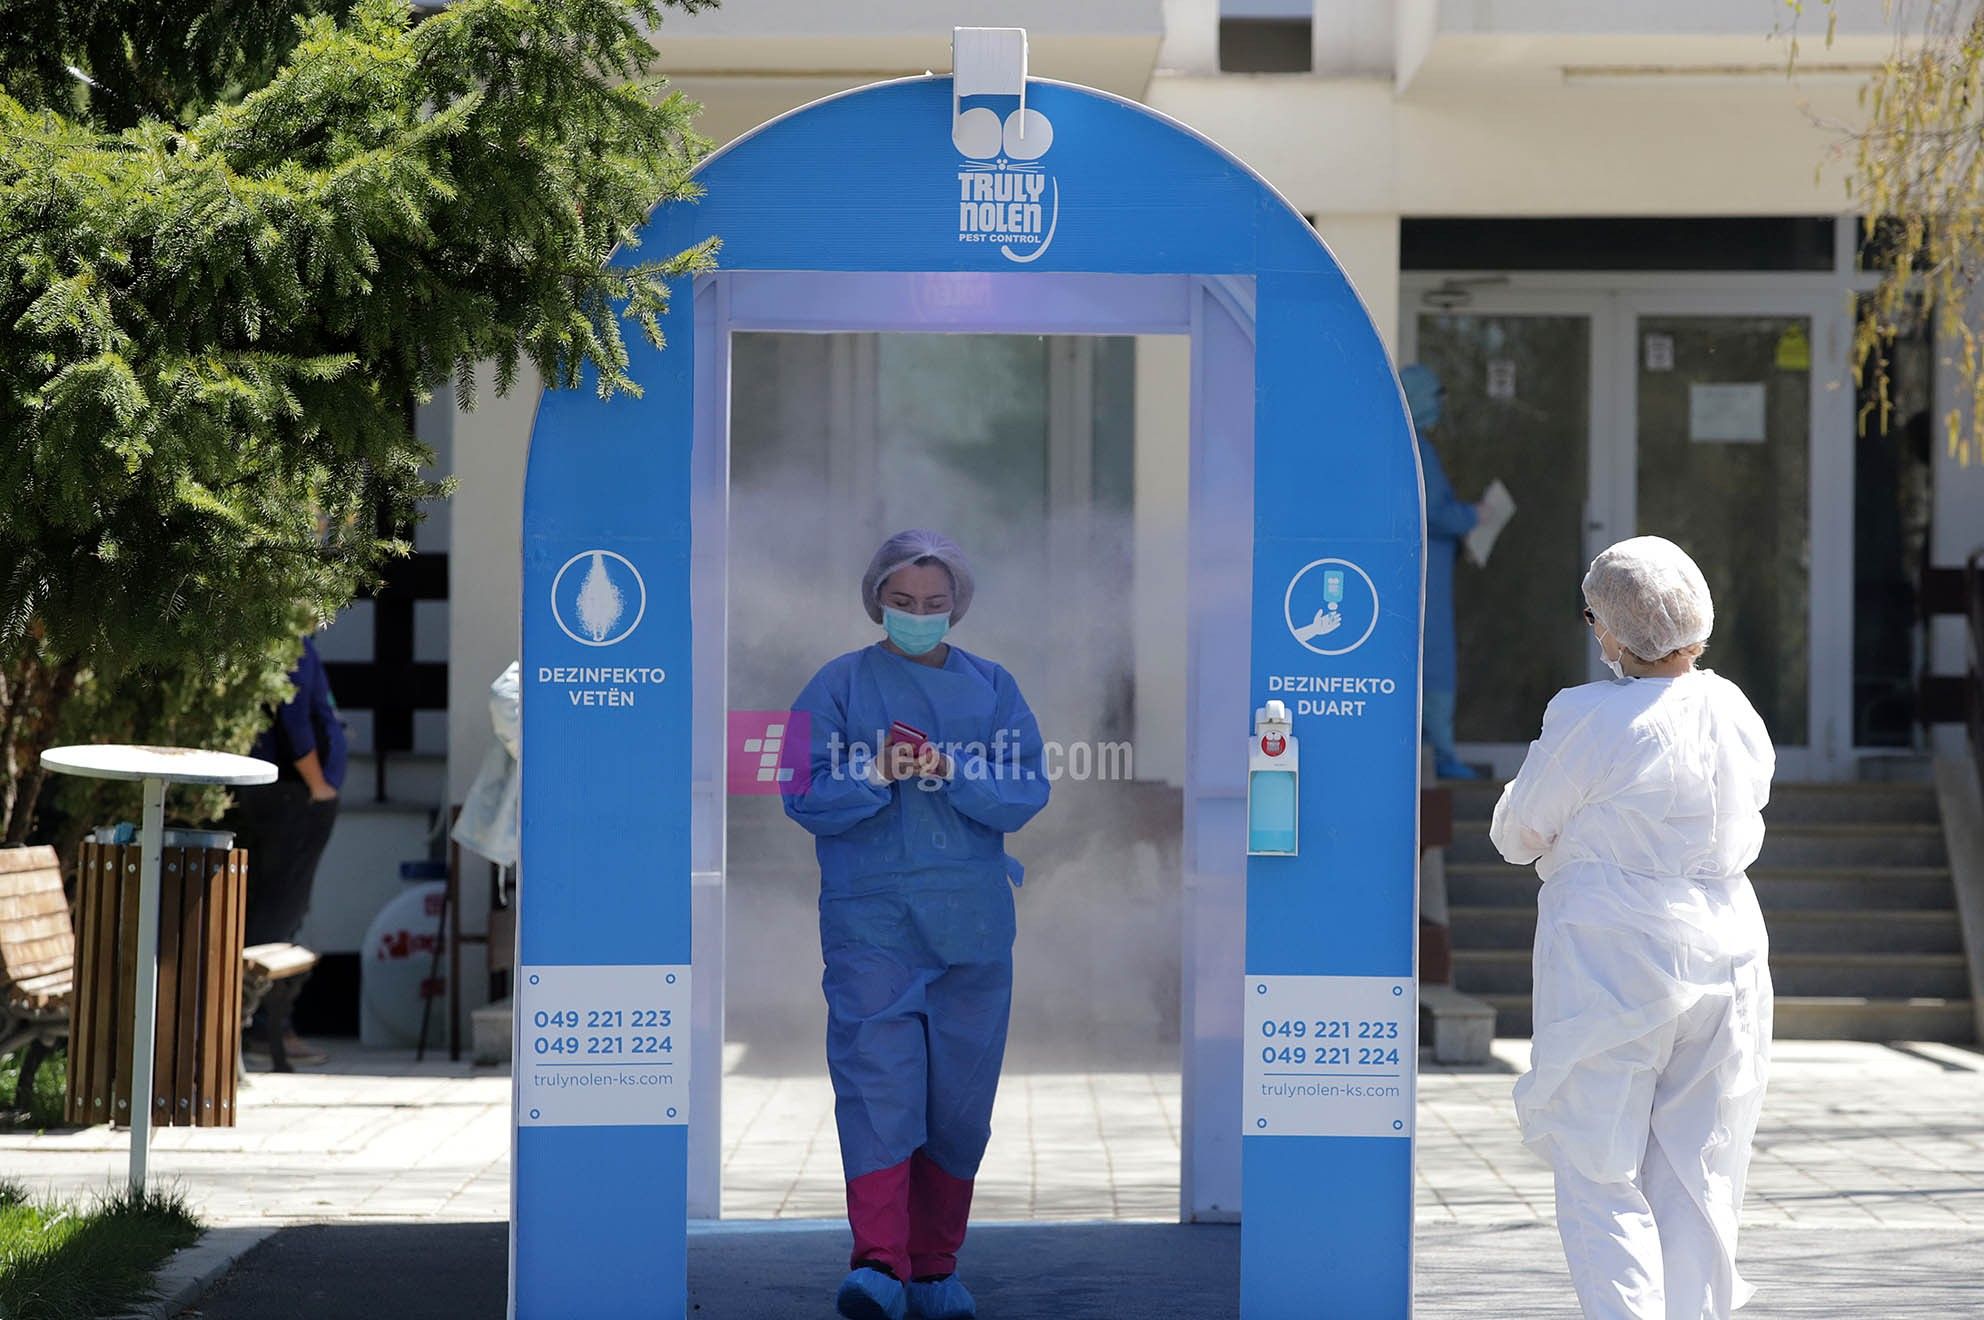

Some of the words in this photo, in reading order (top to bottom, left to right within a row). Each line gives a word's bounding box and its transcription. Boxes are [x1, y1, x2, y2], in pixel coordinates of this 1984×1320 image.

[958, 172, 1045, 202] TRULY
[959, 202, 1042, 233] NOLEN
[959, 233, 987, 243] PEST
[989, 233, 1041, 244] CONTROL
[538, 667, 666, 684] DEZINFEKTO
[1268, 675, 1396, 695] DEZINFEKTO
[568, 688, 635, 707] VETËN
[1297, 699, 1366, 717] DUART
[534, 1010, 579, 1028] 049
[587, 1010, 623, 1028] 221
[631, 1010, 672, 1028] 223
[1262, 1020, 1307, 1038] 049
[1314, 1021, 1349, 1039] 221
[1358, 1021, 1398, 1039] 223
[534, 1036, 579, 1054] 049
[587, 1036, 623, 1054] 221
[631, 1036, 673, 1053] 224
[1262, 1046, 1307, 1064] 049
[1314, 1047, 1349, 1065] 221
[1358, 1047, 1400, 1065] 224
[534, 1072, 673, 1089] trulynolen-ks.com
[1261, 1082, 1400, 1098] trulynolen-ks.com
